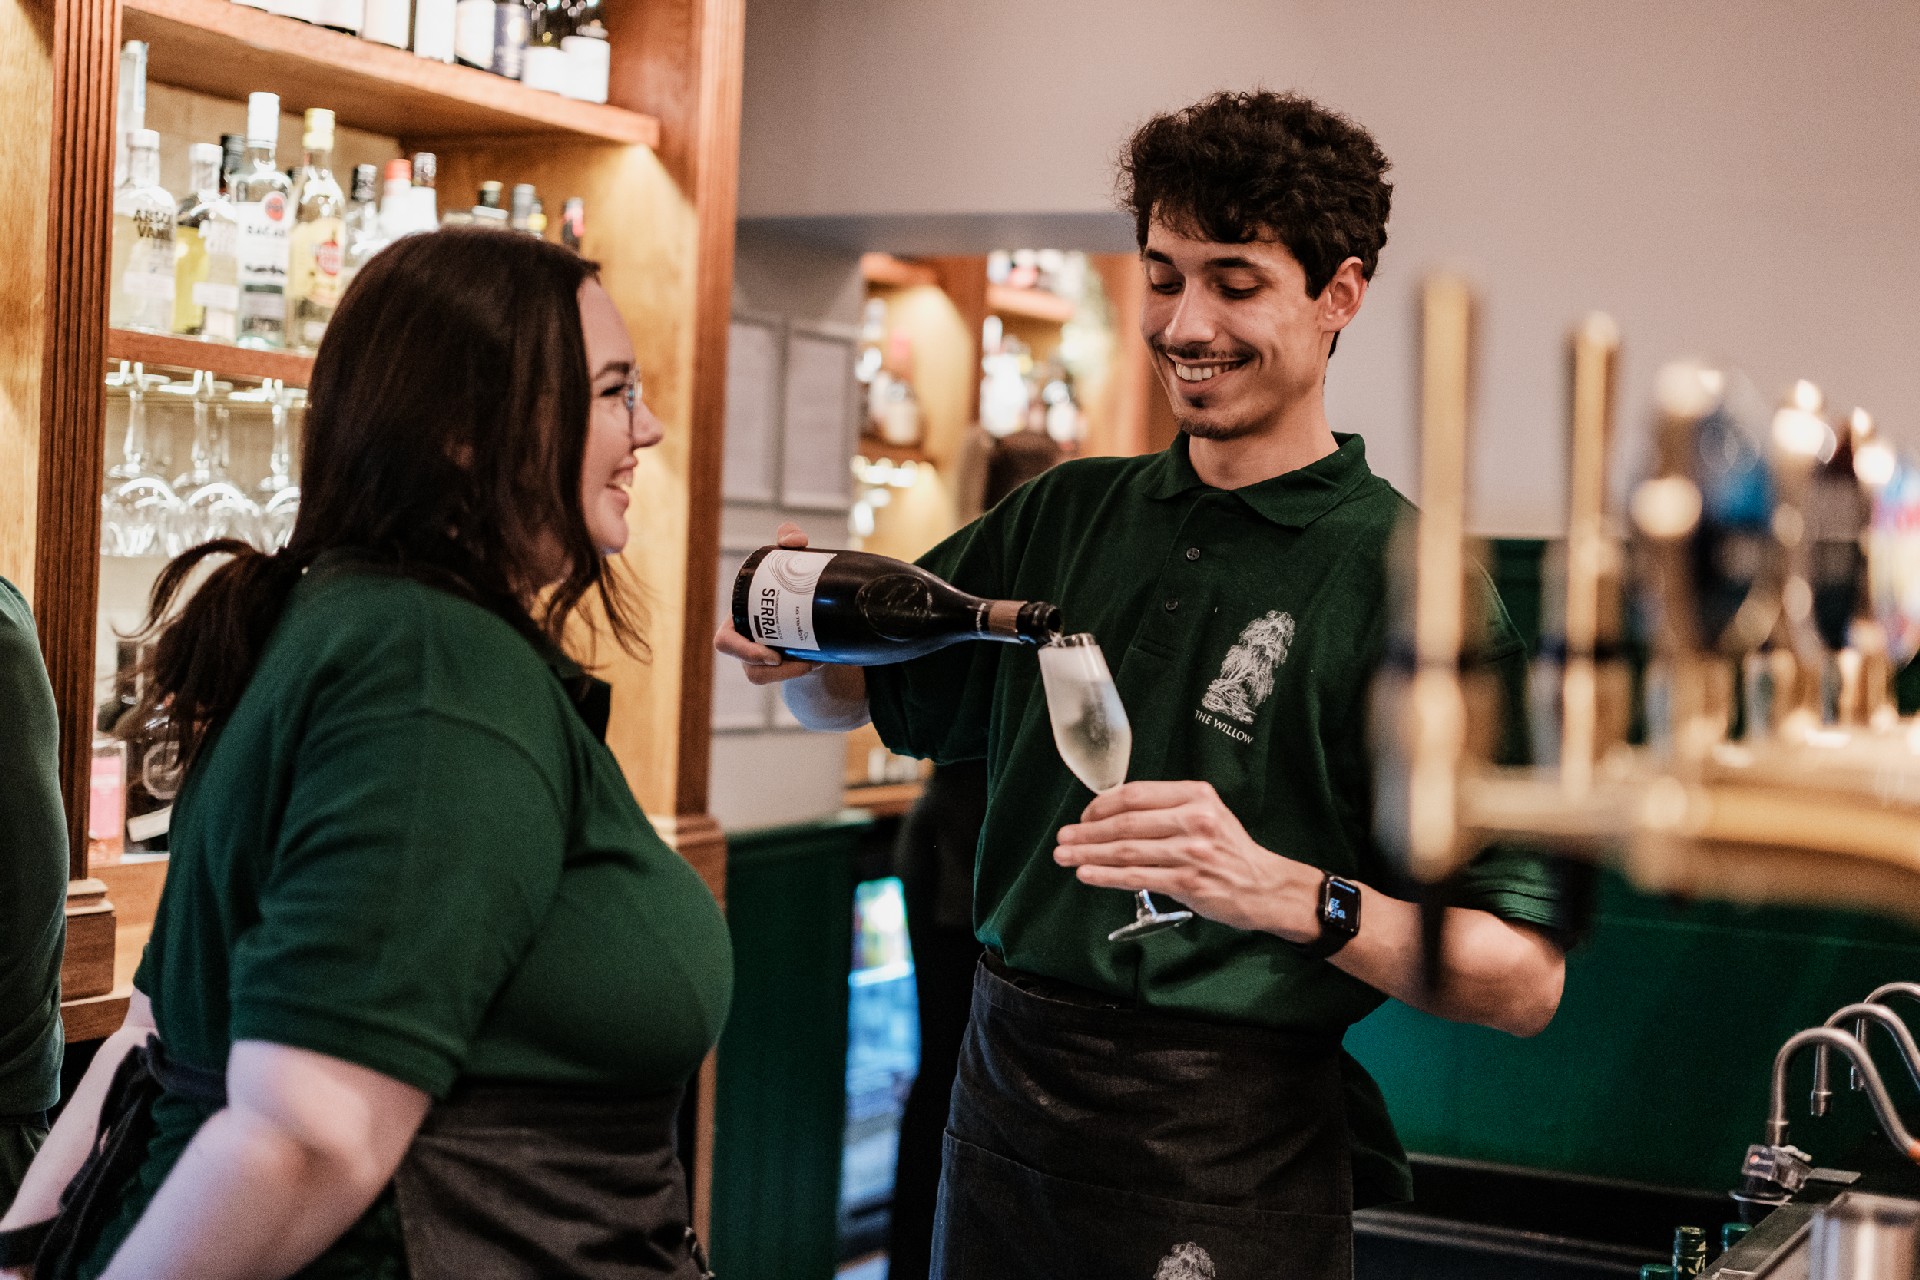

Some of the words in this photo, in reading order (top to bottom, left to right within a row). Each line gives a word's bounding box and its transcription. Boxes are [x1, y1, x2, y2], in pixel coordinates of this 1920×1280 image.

[760, 588, 779, 640] SERRAI
[1195, 709, 1213, 725] THE
[1213, 718, 1254, 744] WILLOW
